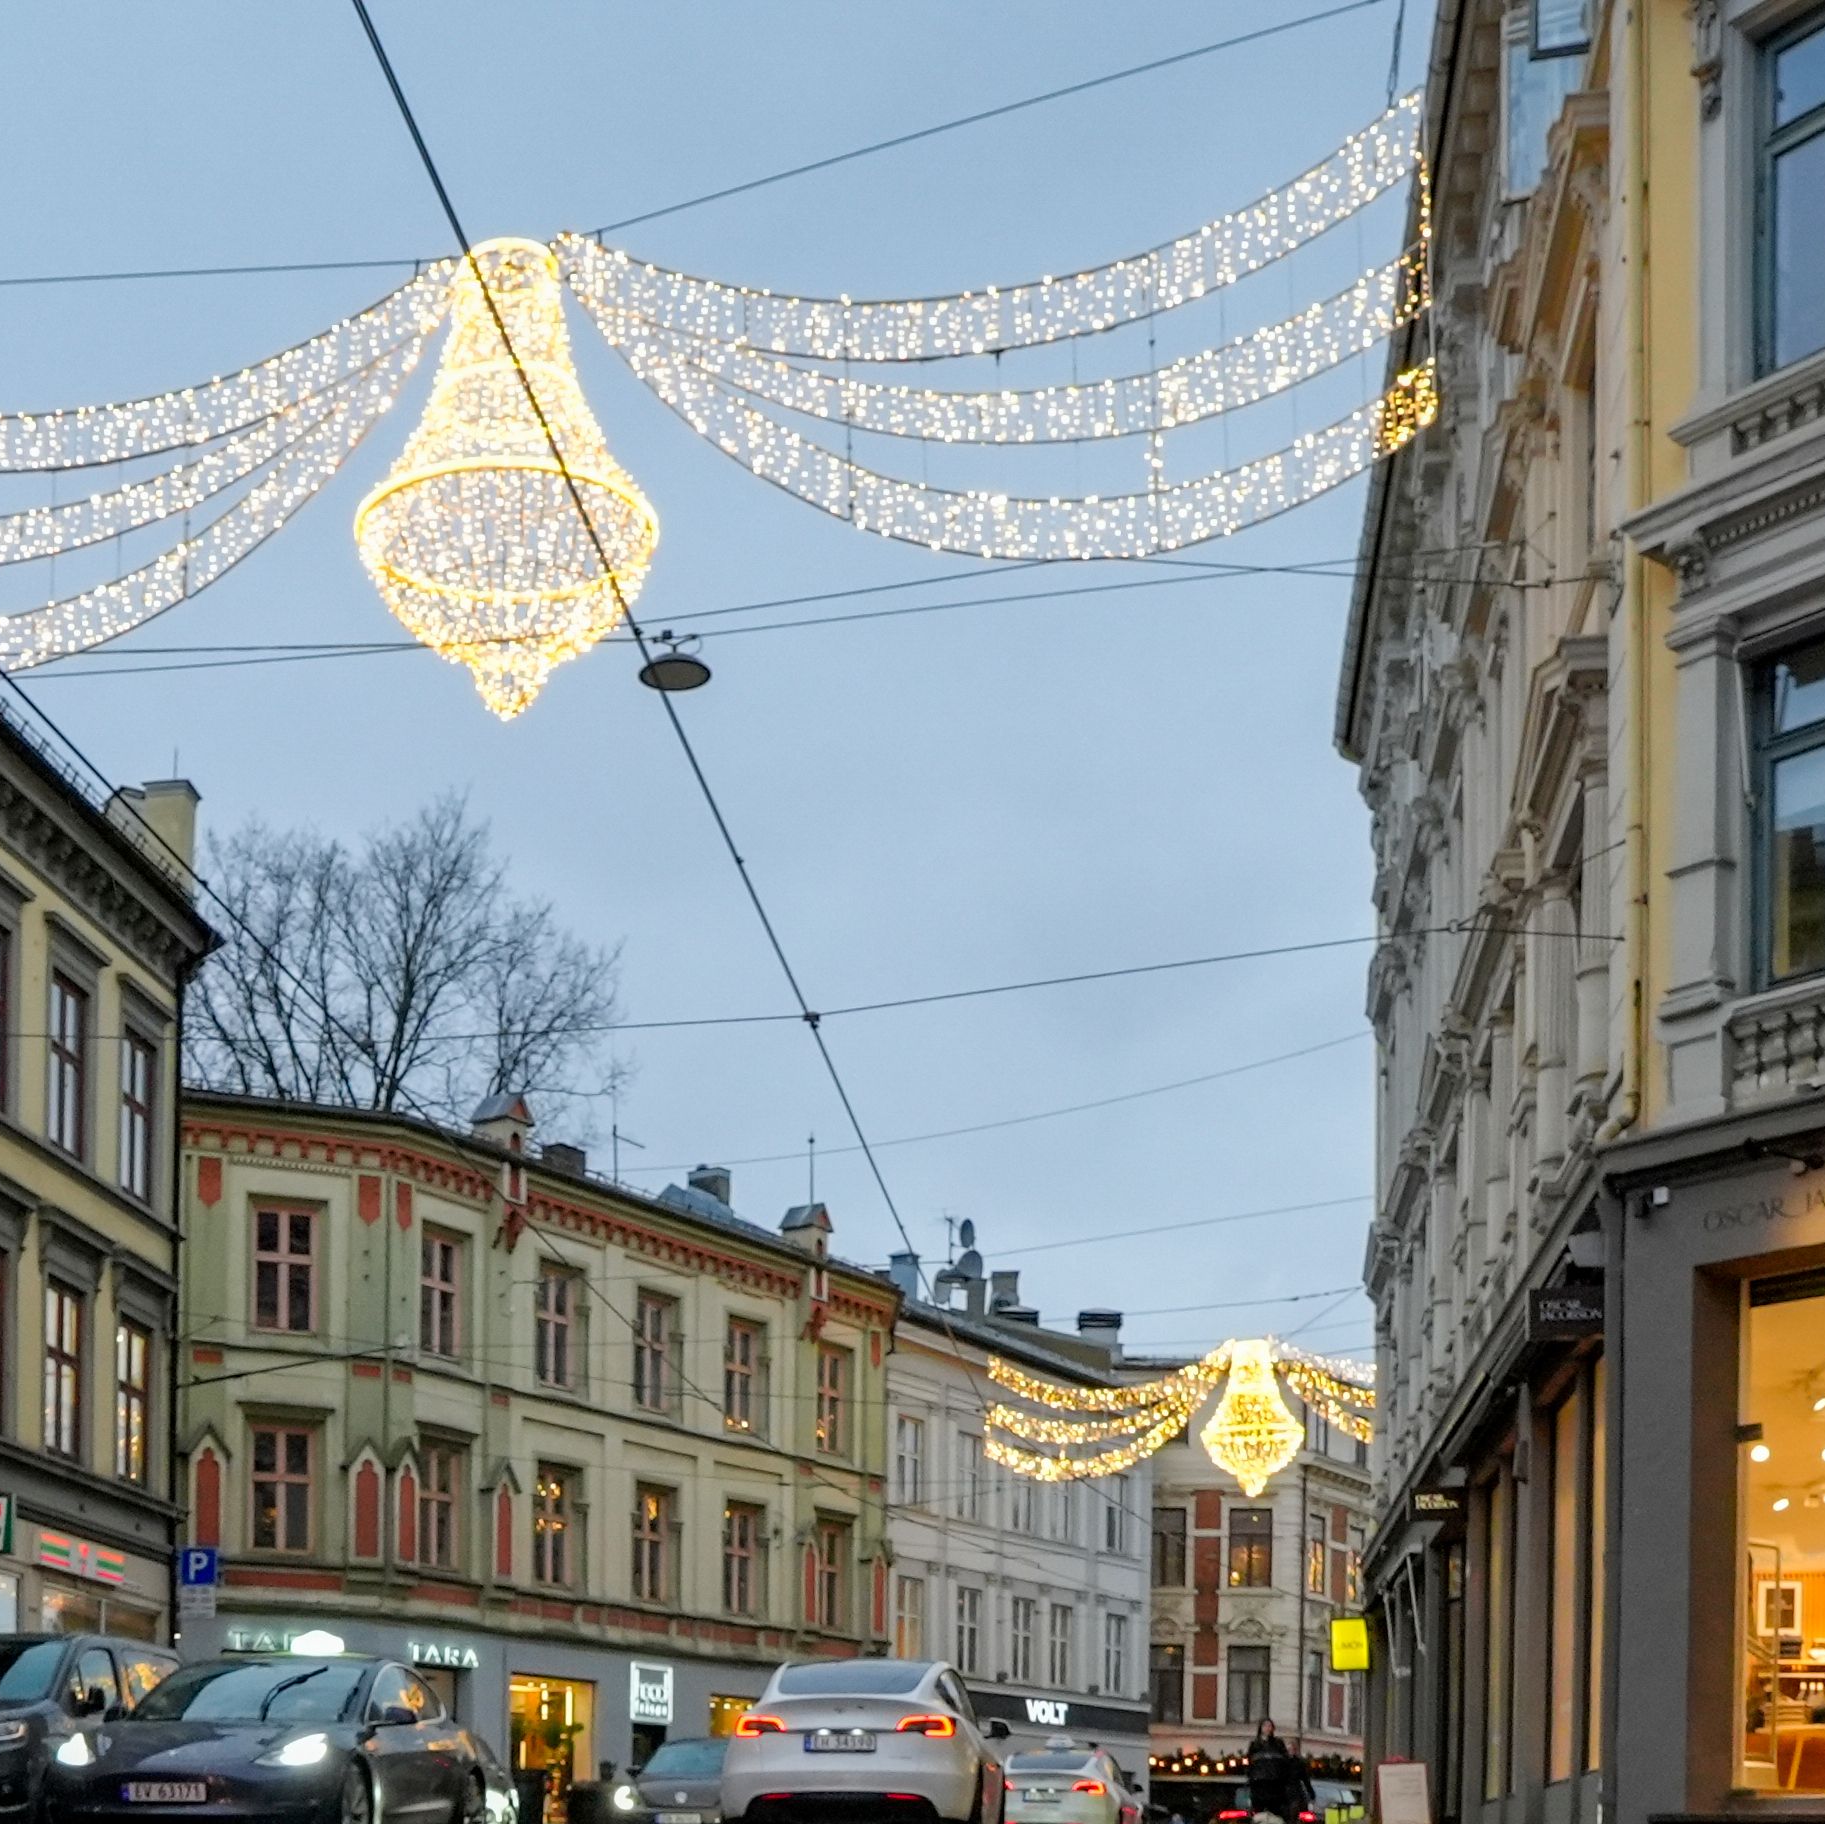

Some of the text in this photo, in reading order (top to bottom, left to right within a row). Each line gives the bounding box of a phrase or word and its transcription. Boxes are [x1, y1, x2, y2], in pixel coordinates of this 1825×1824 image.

[188, 1551, 209, 1581] P
[408, 1642, 479, 1668] TARA
[1025, 1699, 1069, 1725] VOLT
